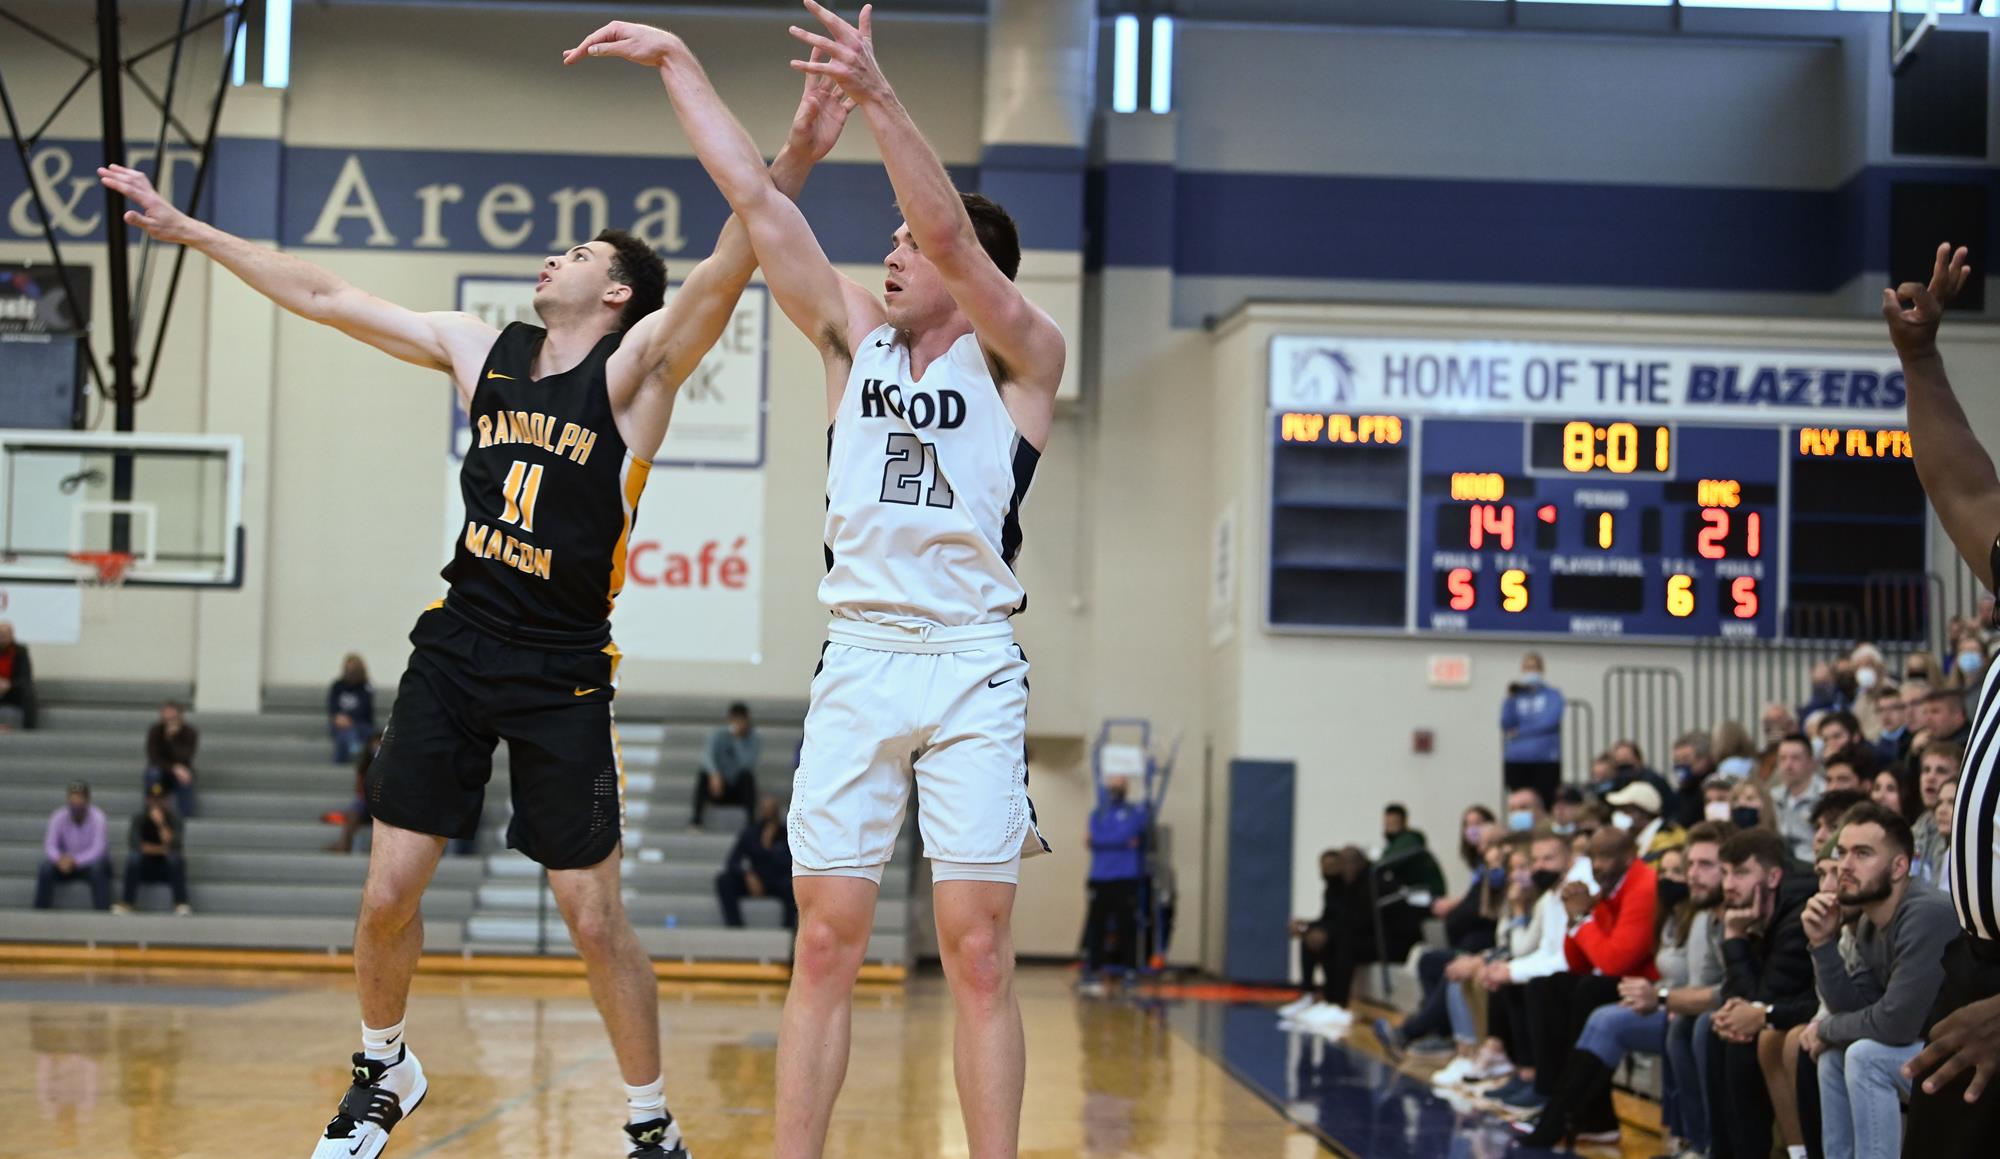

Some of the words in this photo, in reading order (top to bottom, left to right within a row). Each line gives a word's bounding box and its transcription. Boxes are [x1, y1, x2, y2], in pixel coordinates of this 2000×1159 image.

[303, 153, 689, 254] Arena
[861, 378, 967, 430] HOOD
[1383, 354, 1510, 401] HOME
[1523, 357, 1578, 402] OF
[1589, 359, 1670, 405] THE
[1685, 365, 1906, 409] BLAZERS
[477, 410, 598, 466] RANDOLPH
[1563, 421, 1669, 474] 8:01
[498, 460, 545, 532] 11
[879, 432, 954, 509] 21
[465, 521, 552, 580] MACON
[1469, 504, 1514, 550] 14
[1599, 512, 1613, 549] 1
[1698, 508, 1760, 559] 21
[628, 535, 748, 589] Café
[1667, 574, 1694, 617] 6
